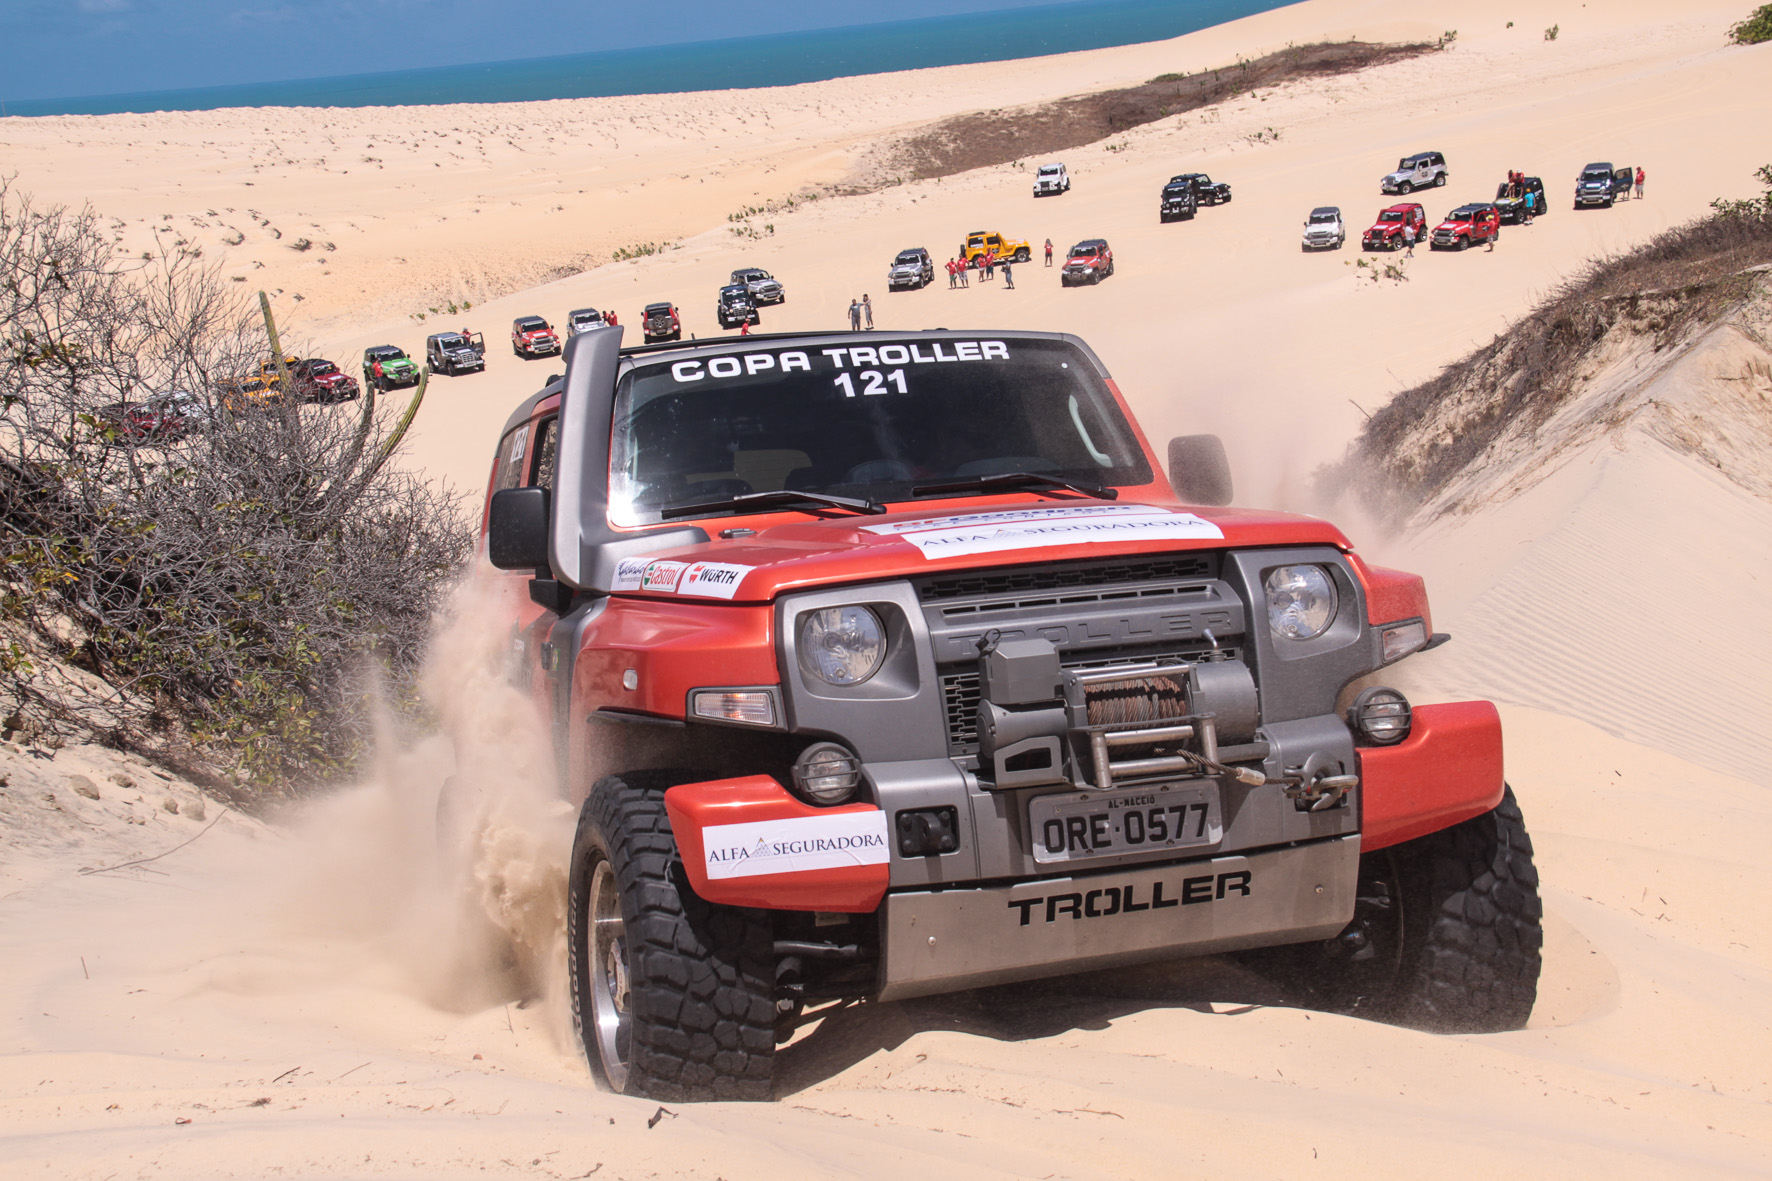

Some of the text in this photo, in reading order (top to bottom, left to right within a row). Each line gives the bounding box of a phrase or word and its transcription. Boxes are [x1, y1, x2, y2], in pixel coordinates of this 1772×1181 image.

[671, 341, 1010, 383] COPA TROLLER
[834, 369, 908, 397] 121
[922, 534, 990, 548] ALFA
[650, 565, 682, 586] Castrol
[699, 568, 740, 585] WÜRTH
[709, 834, 884, 862] ALFA SEGURADORA
[1007, 870, 1252, 926] TROLLER
